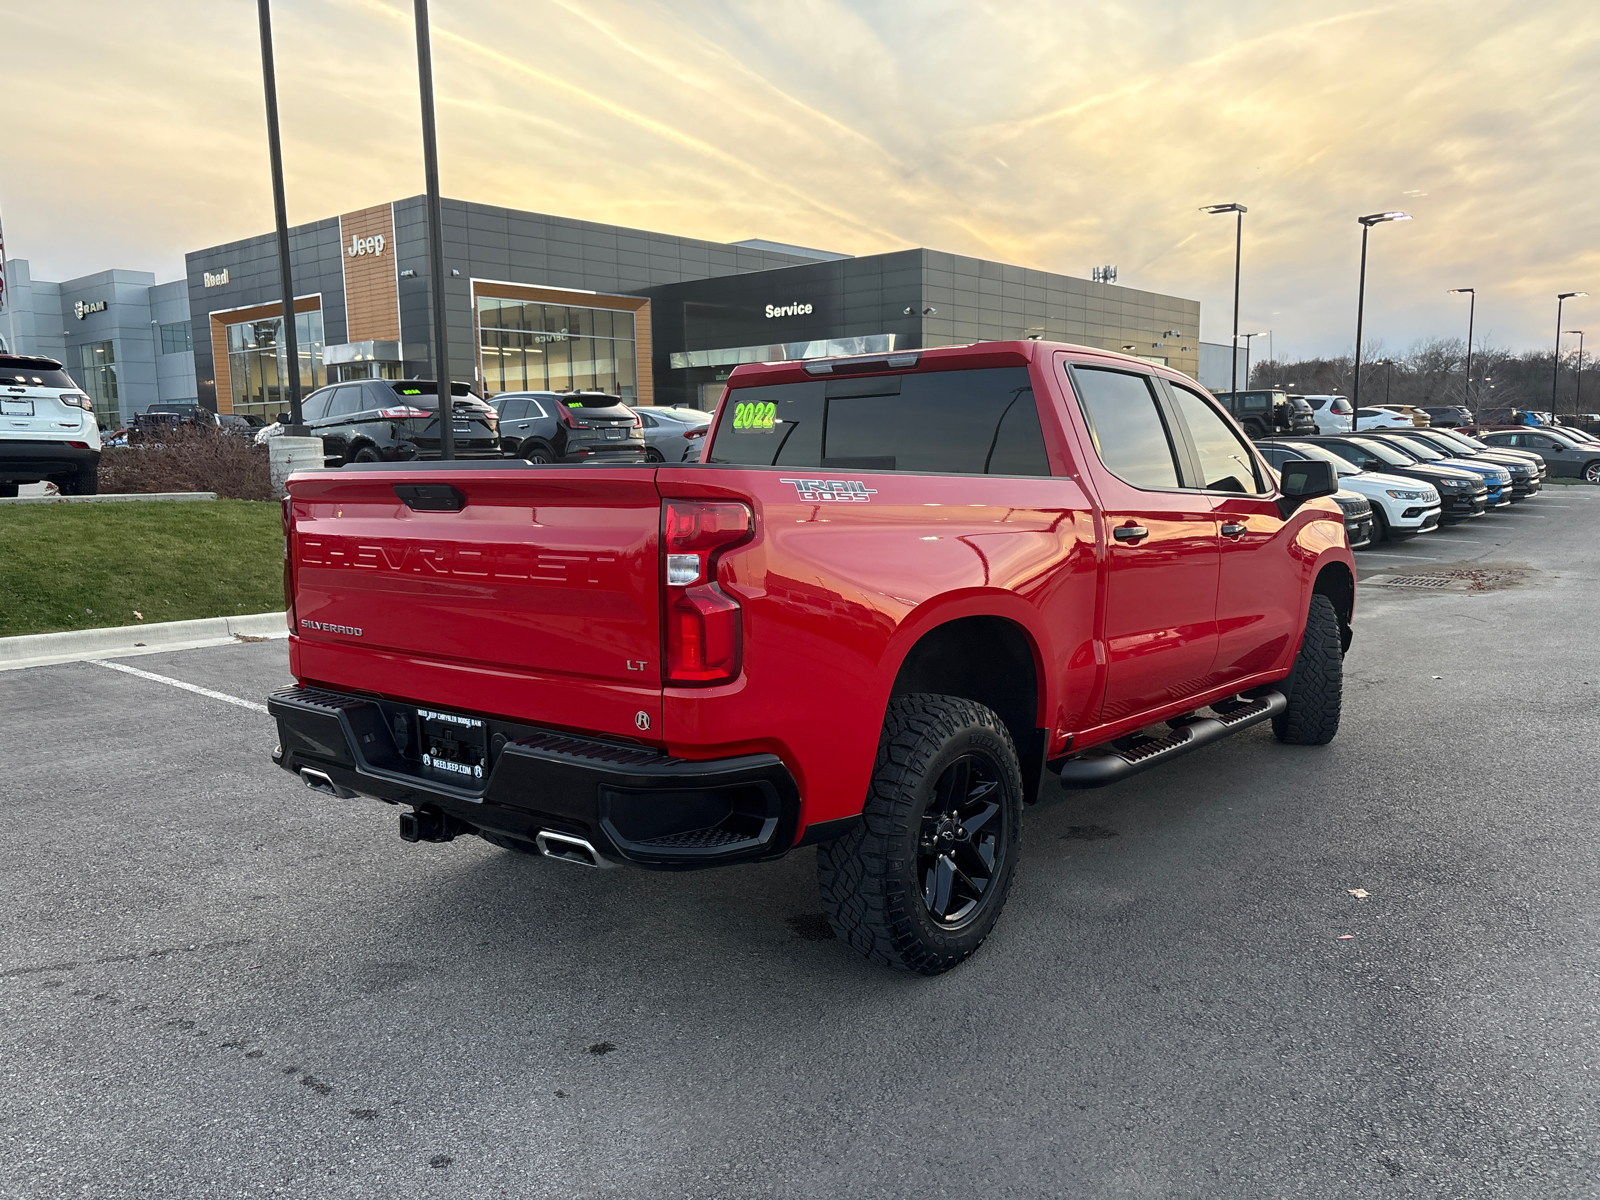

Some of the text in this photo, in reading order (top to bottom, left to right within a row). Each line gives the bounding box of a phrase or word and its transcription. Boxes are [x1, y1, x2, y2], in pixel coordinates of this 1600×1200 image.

[347, 234, 386, 257] Jeep
[203, 268, 229, 288] Reed
[83, 301, 106, 314] RAM
[765, 301, 813, 319] Service
[732, 402, 777, 430] 2022
[779, 478, 878, 494] TRAIL
[798, 490, 871, 503] BOSS
[301, 541, 616, 583] CHEVROLET
[300, 618, 363, 637] SILVERADO
[626, 659, 649, 672] LT
[432, 758, 472, 776] REEDJEEP.COM
